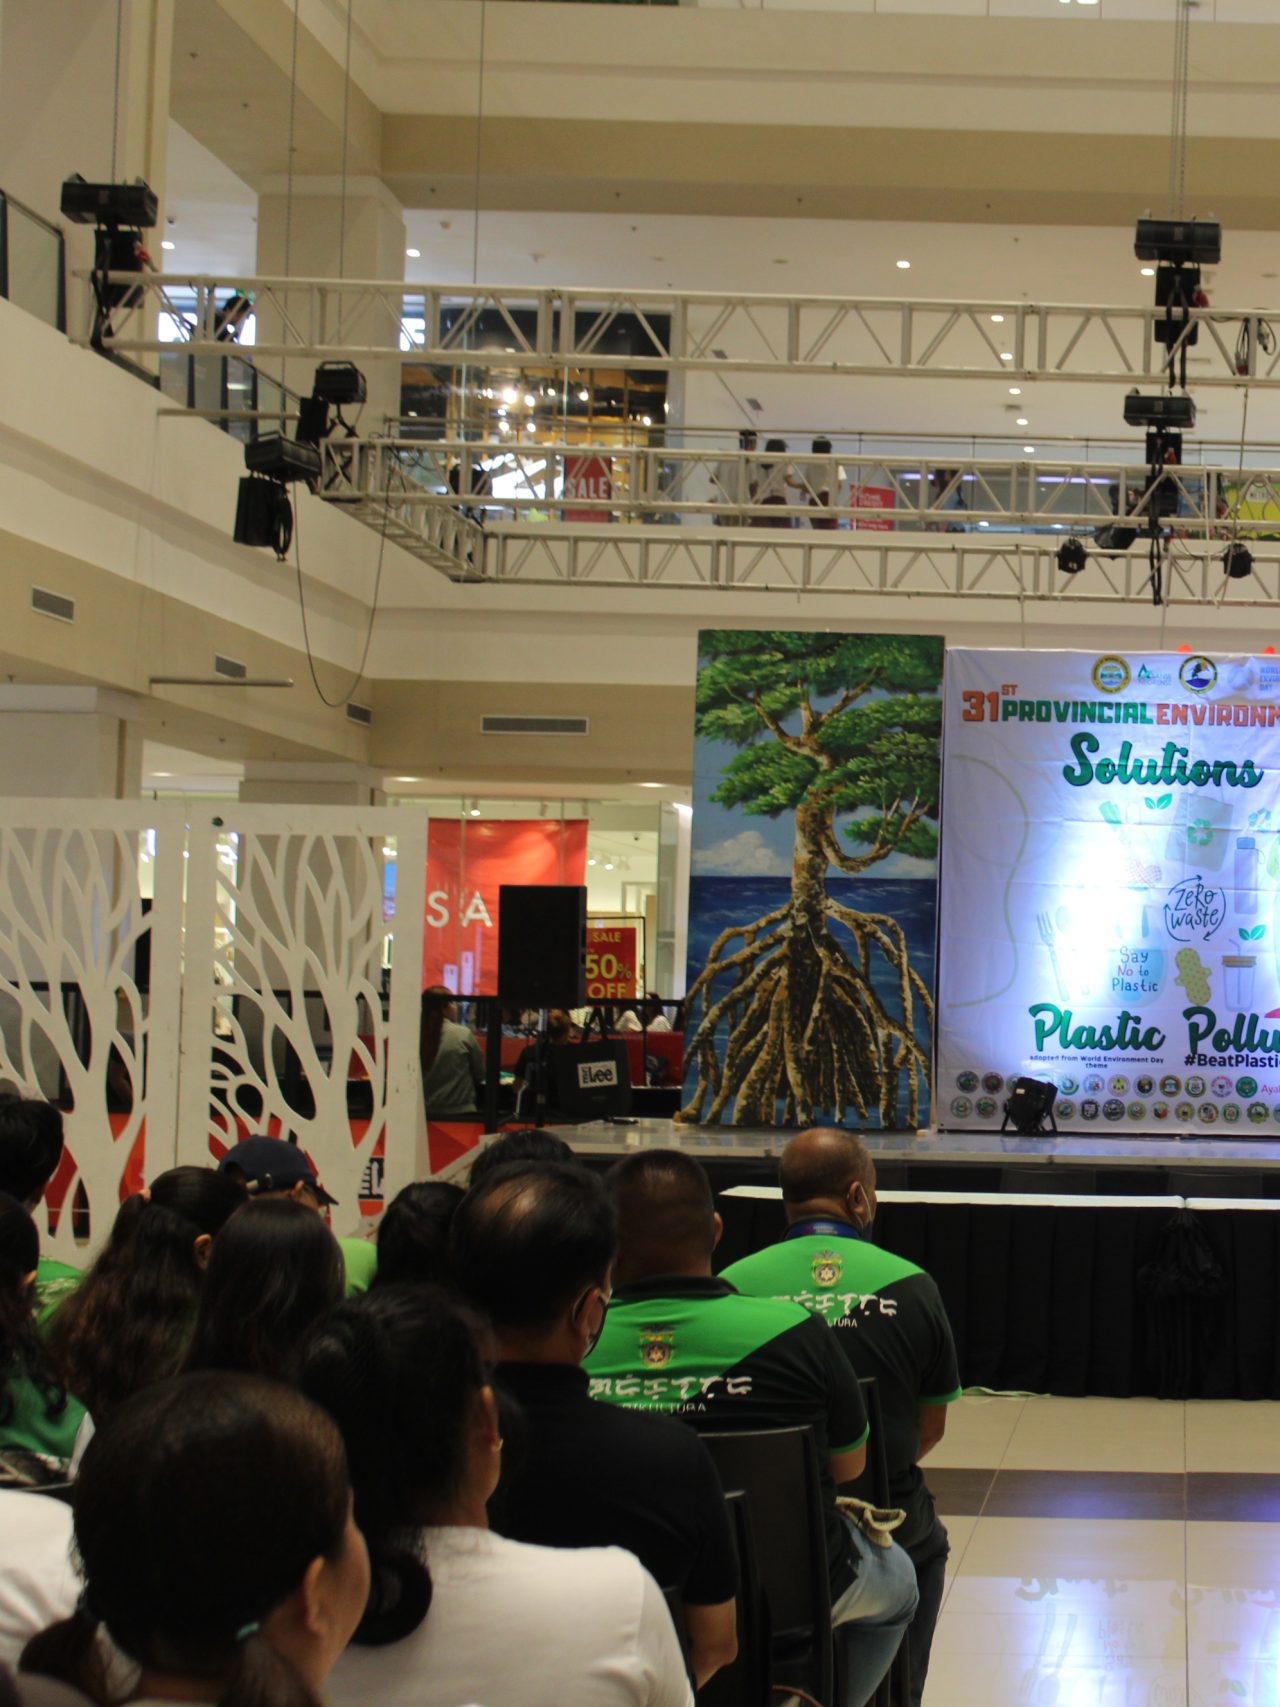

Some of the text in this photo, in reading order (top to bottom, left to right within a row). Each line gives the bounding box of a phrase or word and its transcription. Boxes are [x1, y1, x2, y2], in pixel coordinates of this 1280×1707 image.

[1002, 700, 1154, 725] PROVINCIAL
[1063, 731, 1264, 788] Solutions
[592, 931, 621, 943] SALE
[1120, 946, 1148, 963] Say
[585, 954, 632, 980] 50%
[1117, 964, 1149, 976] No to
[587, 983, 627, 999] OFF
[1112, 977, 1158, 992] Plastic
[1028, 1002, 1166, 1052] Plastic
